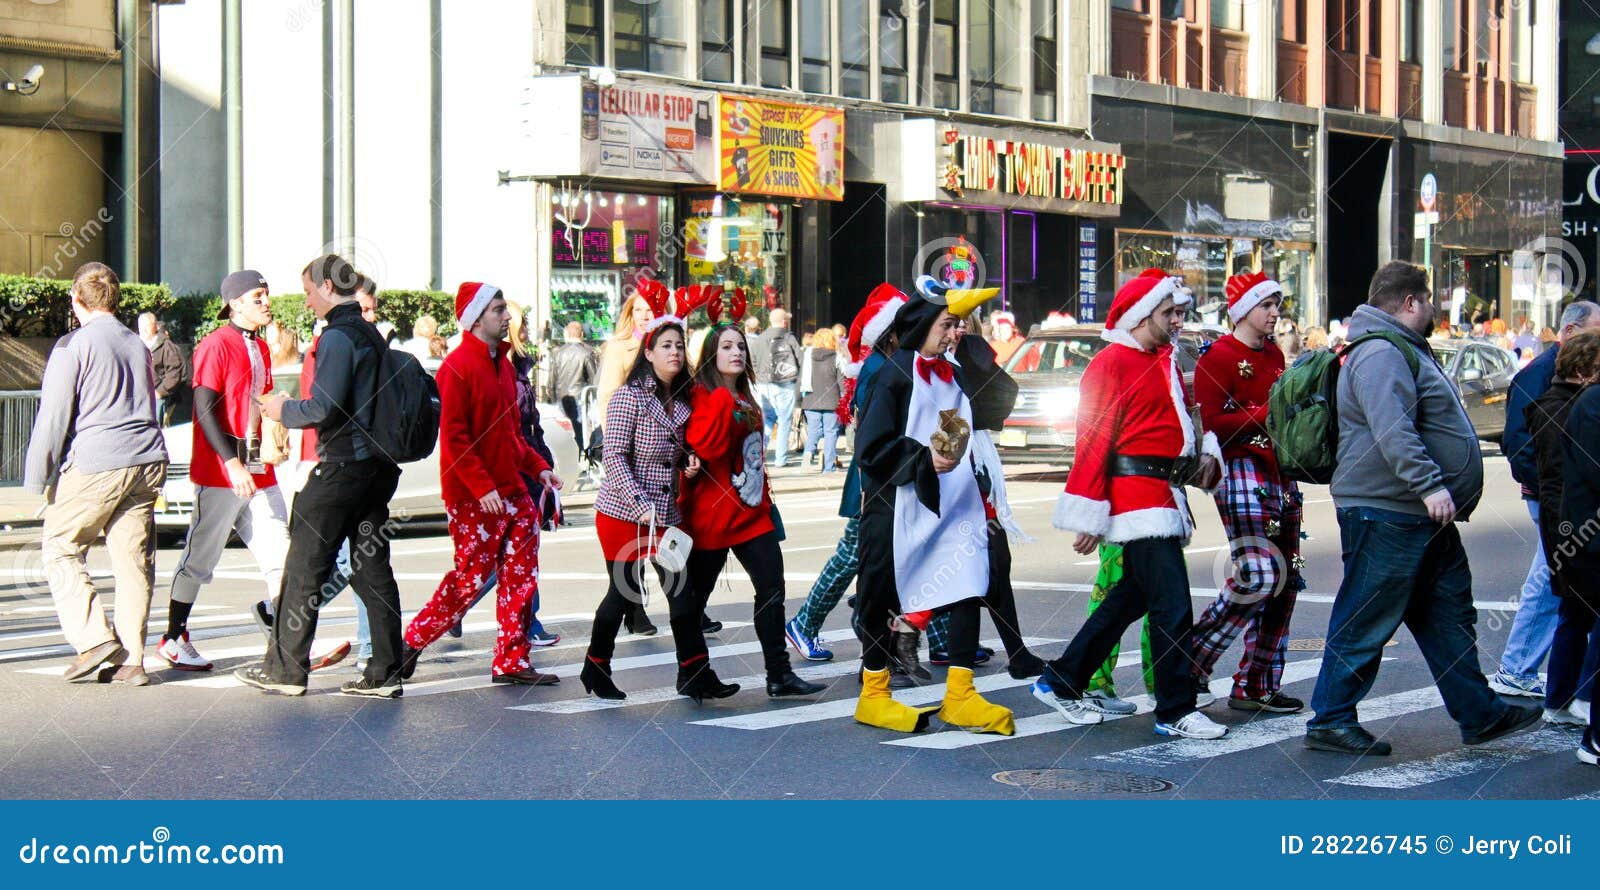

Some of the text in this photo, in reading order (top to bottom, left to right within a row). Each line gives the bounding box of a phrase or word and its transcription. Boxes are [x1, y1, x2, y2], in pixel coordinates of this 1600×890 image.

[600, 87, 694, 122] CELLULAR STOP
[760, 126, 805, 149] SOUVENIRS
[636, 150, 661, 161] NOKIA
[769, 149, 796, 168] GIFTS
[765, 169, 800, 187] & SHOES
[960, 135, 1126, 205] MID TOWN BUFFET
[762, 231, 785, 252] NY
